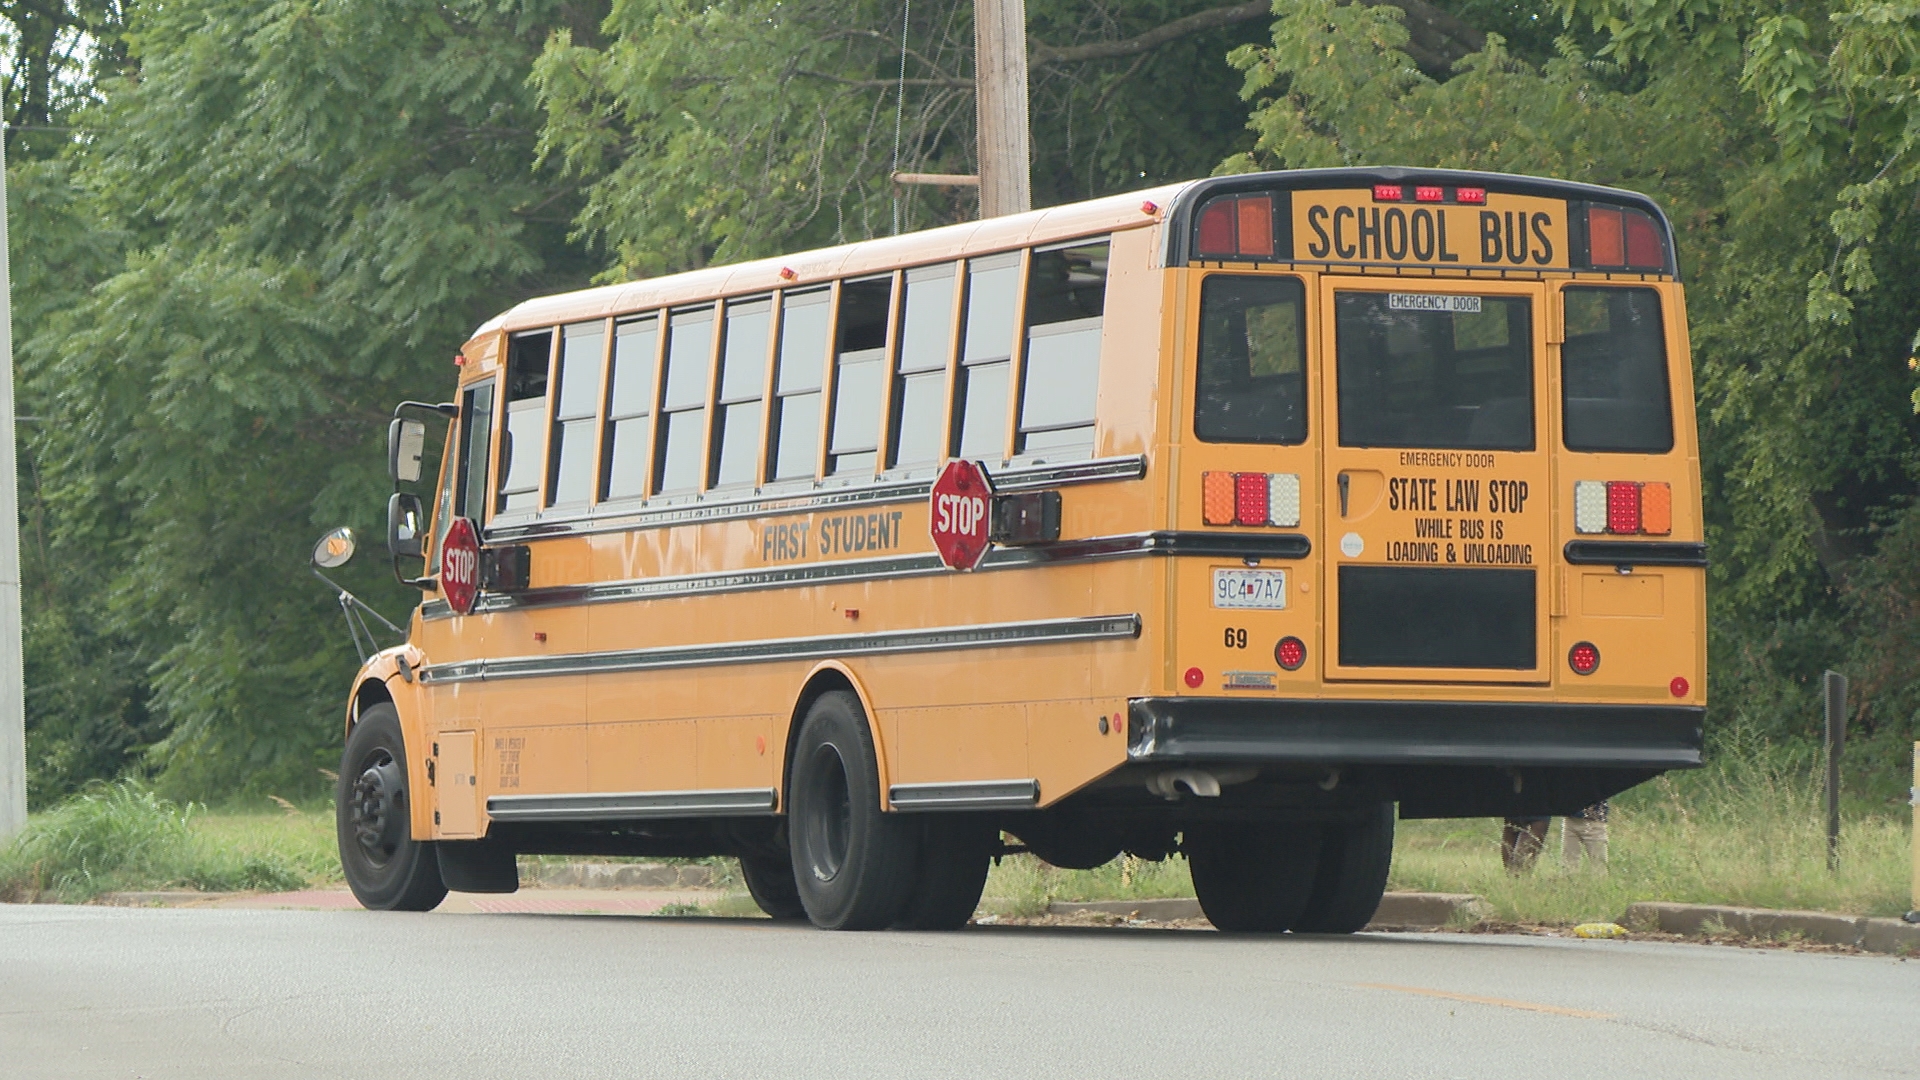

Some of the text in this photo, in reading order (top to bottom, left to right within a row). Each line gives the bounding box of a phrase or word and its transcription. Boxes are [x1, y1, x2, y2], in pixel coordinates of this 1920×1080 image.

[1307, 205, 1553, 266] SCHOOL BUS
[1390, 294, 1480, 311] EMERGENCY DOOR
[1400, 452, 1495, 468] EMERGENCY DOOR
[1389, 477, 1529, 514] STATE LAW STOP
[937, 494, 984, 537] STOP
[1415, 518, 1503, 540] WHILE BUS IS
[762, 511, 903, 561] FIRST STUDENT
[445, 547, 475, 585] STOP
[1386, 541, 1532, 564] LOADING & UNLOADING
[1224, 627, 1247, 649] 69
